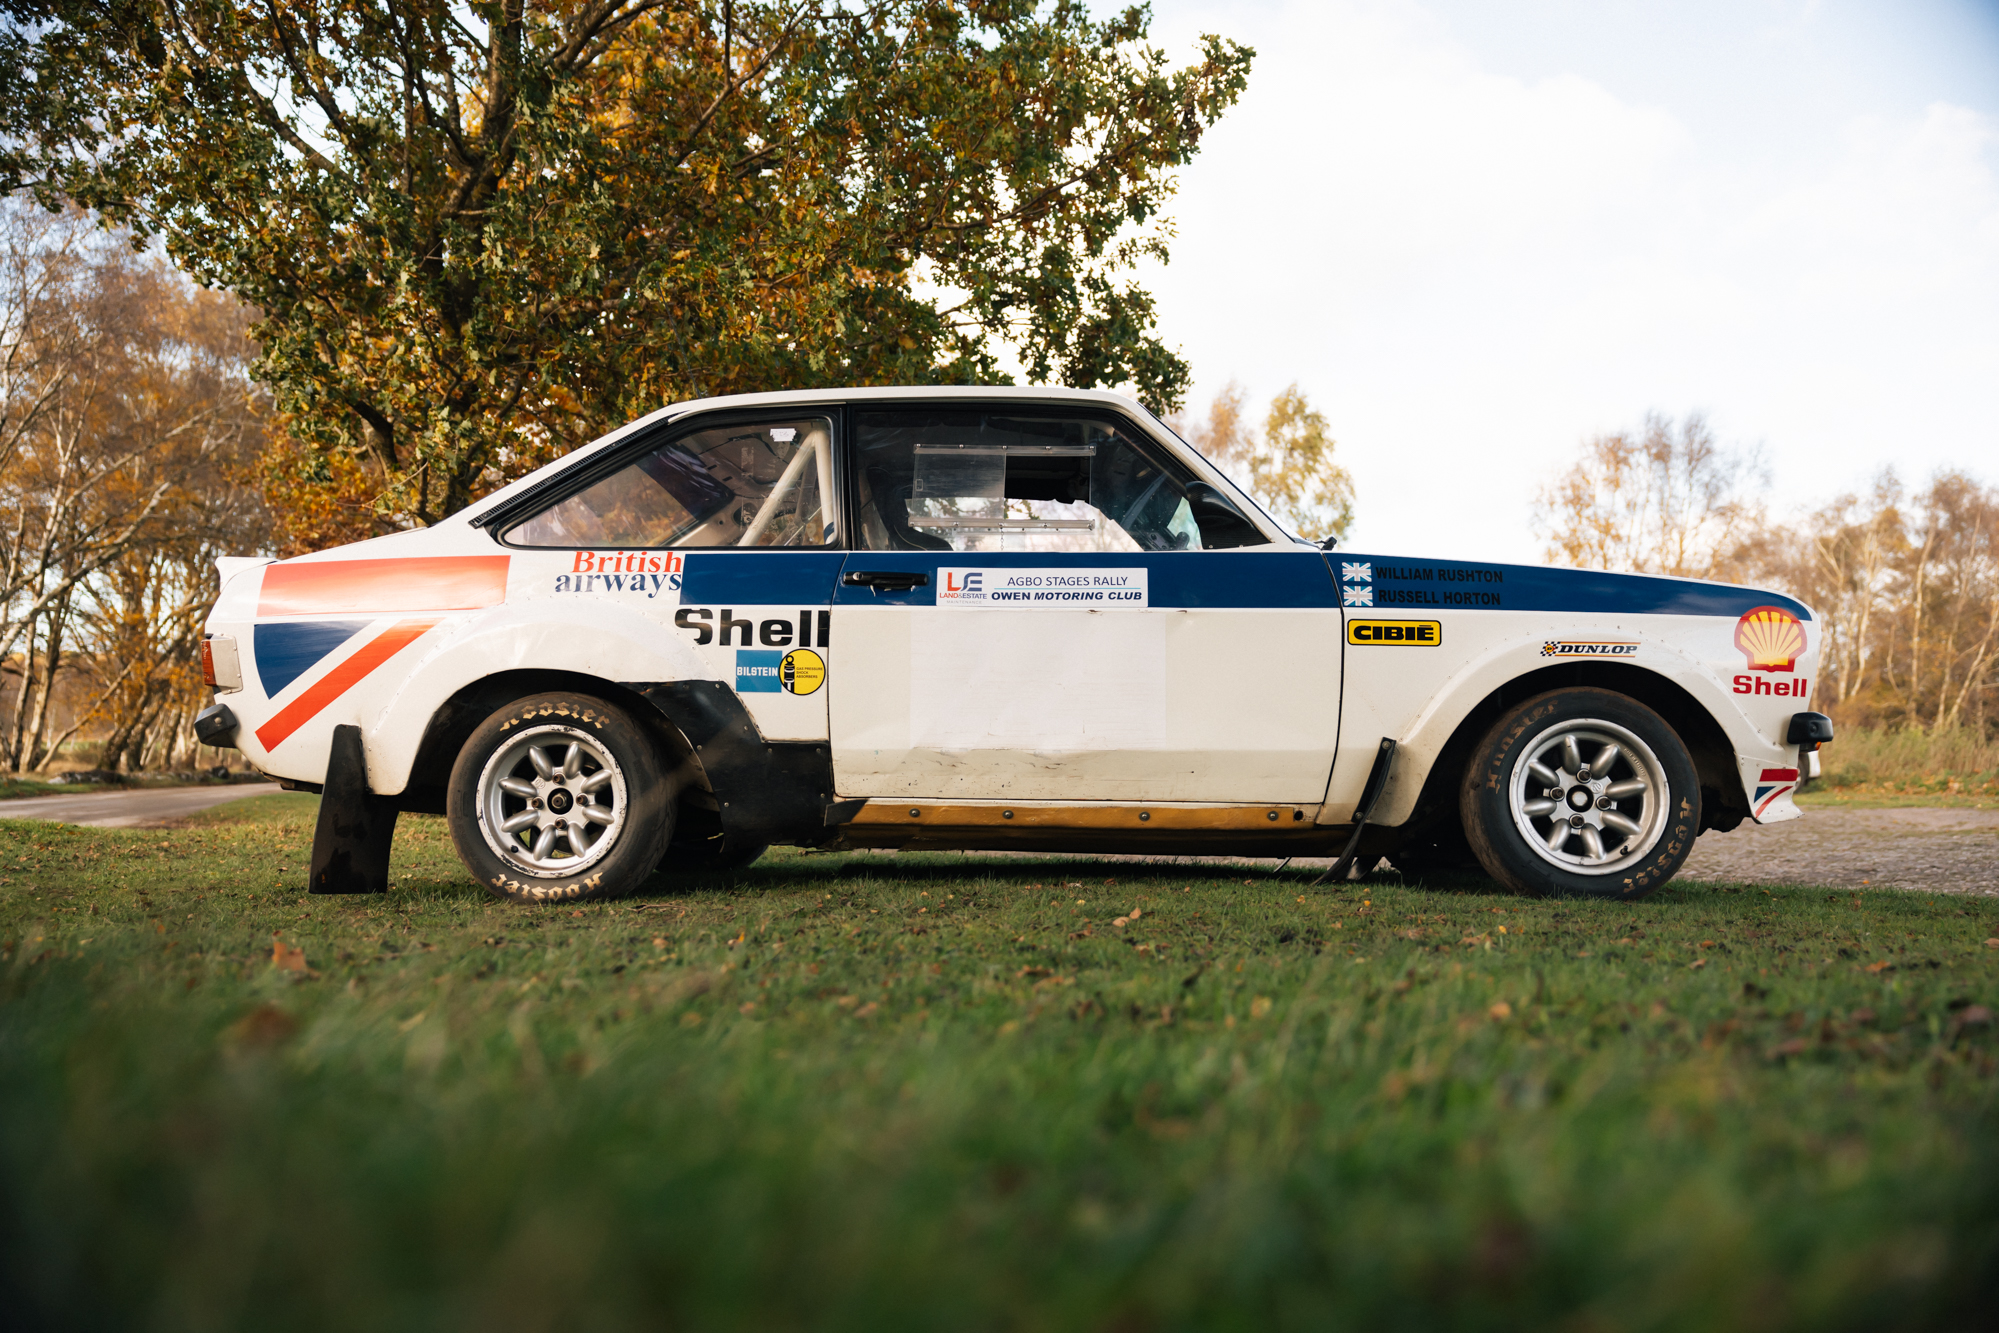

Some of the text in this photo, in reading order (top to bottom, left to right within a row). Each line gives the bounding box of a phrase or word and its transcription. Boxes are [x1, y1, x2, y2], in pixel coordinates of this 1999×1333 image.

[571, 551, 682, 573] British
[1007, 576, 1129, 587] AGBO STAGES RALLY
[1375, 567, 1504, 583] WILLIAM RUSHTON
[555, 574, 682, 598] airways
[991, 591, 1143, 601] OWEN MOTORING CLUB
[1378, 589, 1501, 605] RUSSELL HORTON
[674, 608, 830, 647] Shell
[1558, 644, 1638, 654] DUNLOP
[736, 666, 779, 677] BILSTEIN
[1733, 675, 1808, 698] Shell
